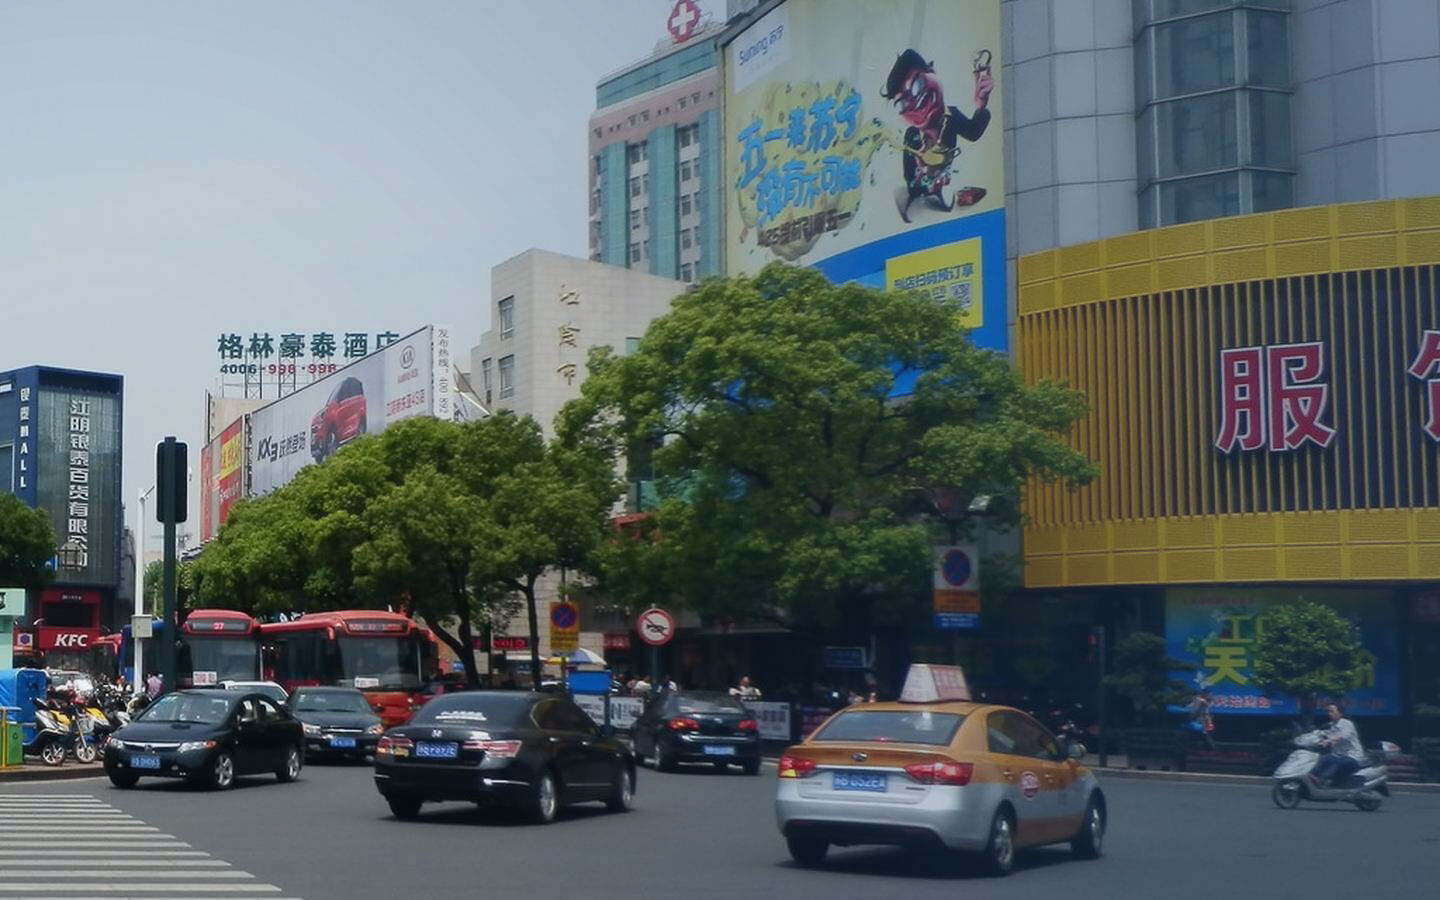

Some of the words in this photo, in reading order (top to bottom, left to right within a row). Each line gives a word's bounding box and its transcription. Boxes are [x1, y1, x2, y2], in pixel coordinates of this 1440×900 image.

[217, 331, 400, 360] 格林豪泰酒店
[55, 634, 88, 647] KFC
